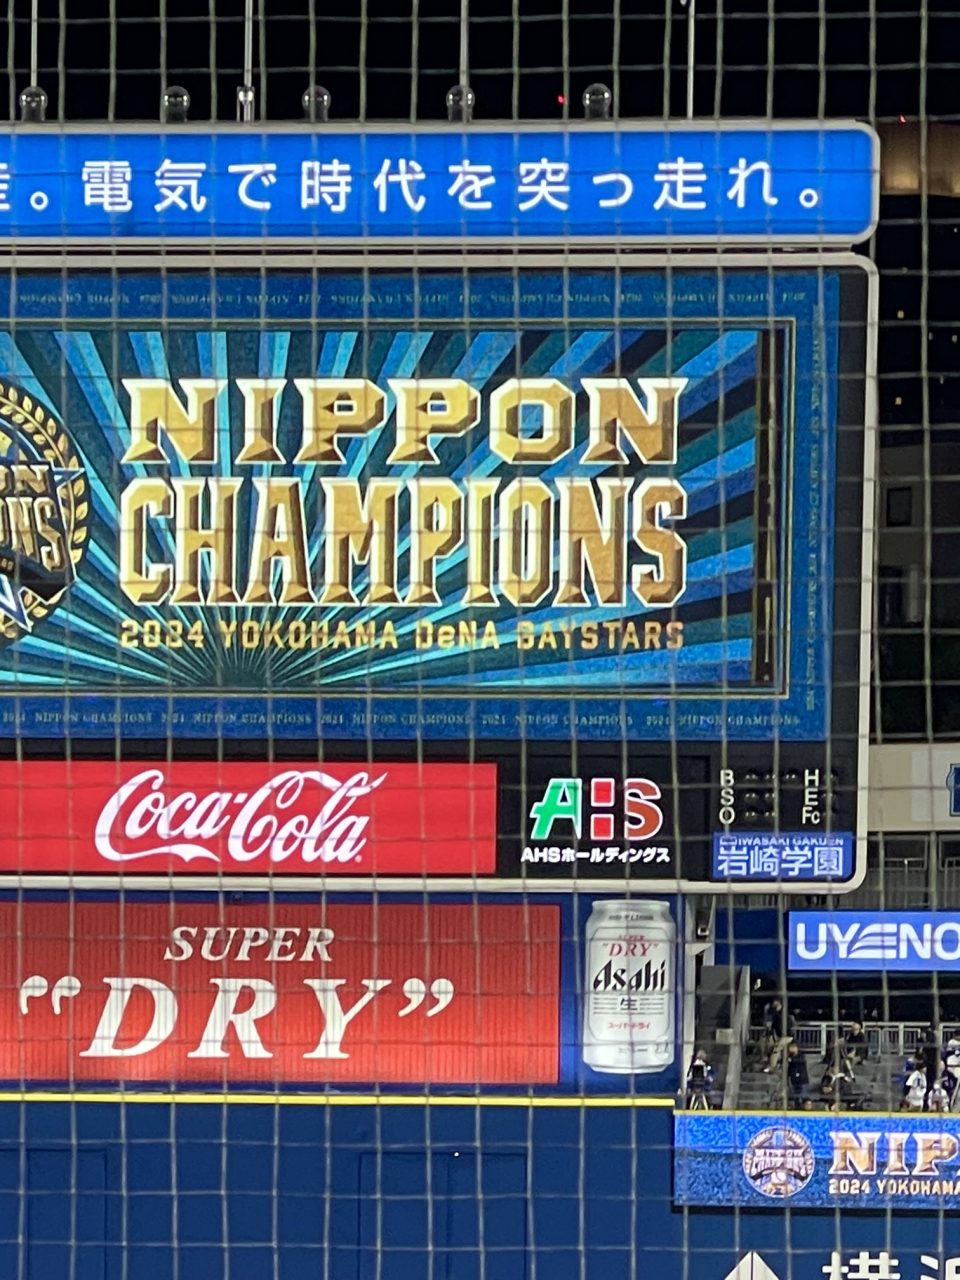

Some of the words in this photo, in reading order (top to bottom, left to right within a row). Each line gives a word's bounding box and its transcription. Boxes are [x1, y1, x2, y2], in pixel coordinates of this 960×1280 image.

[121, 378, 688, 465] NIPPON
[119, 476, 687, 607] CHAMPIONS
[121, 621, 203, 649] 2024
[220, 621, 399, 649] YOKOHAMA
[415, 621, 500, 649] DeNA
[516, 621, 685, 649] BAYSTARS
[94, 769, 388, 863] Coca-Cola
[520, 846, 671, 863] AHSホールディングス
[717, 845, 843, 876] 岩崎学園
[163, 926, 336, 961] SUPER
[796, 922, 960, 960] UYENO
[593, 960, 666, 992] Asahi
[19, 975, 455, 1059] “DRY”
[620, 998, 638, 1011] 生
[827, 1131, 960, 1176] NIP
[828, 1179, 870, 1194] 2024
